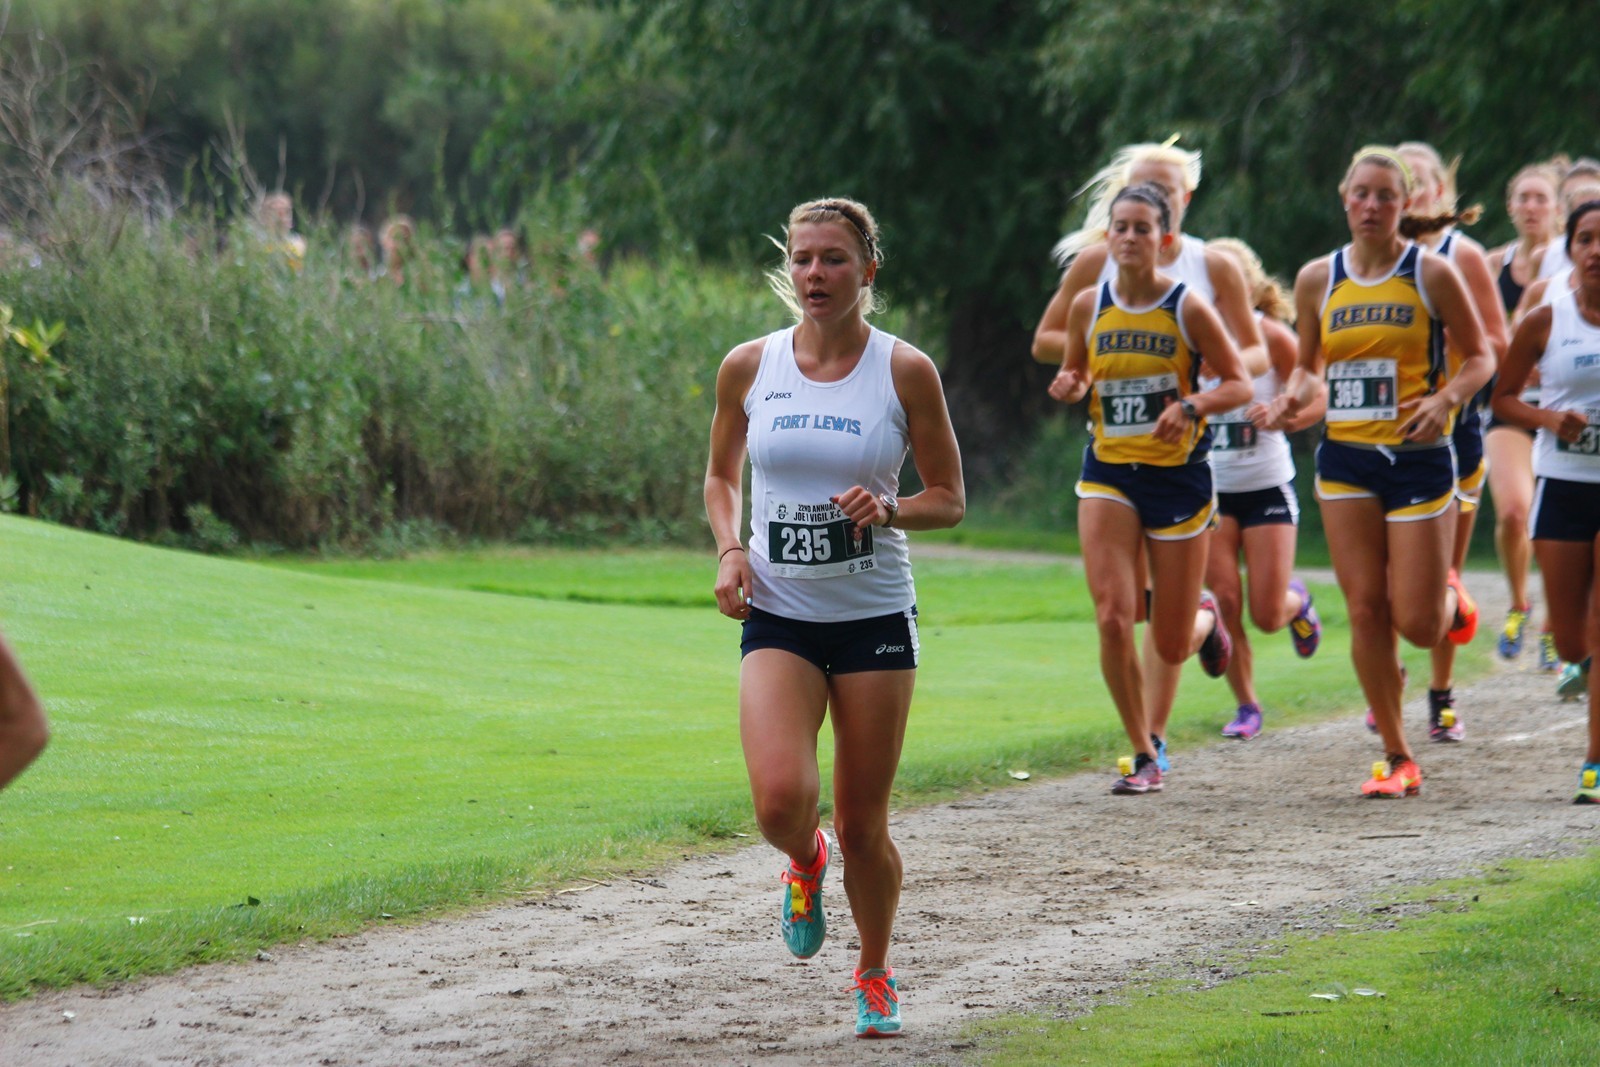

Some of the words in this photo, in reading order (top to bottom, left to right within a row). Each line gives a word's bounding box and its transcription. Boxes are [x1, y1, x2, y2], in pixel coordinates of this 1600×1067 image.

[1328, 304, 1415, 333] REGIS
[1097, 330, 1177, 358] REGIS
[1334, 379, 1365, 408] 369
[1112, 396, 1149, 424] 372
[770, 414, 810, 432] FORT
[813, 414, 862, 436] LEWIS
[793, 511, 806, 521] JOE
[809, 512, 829, 522] VIGIL
[798, 503, 811, 513] 22ND
[812, 502, 836, 513] ANNUAL
[781, 526, 832, 562] 235
[859, 559, 874, 570] 235
